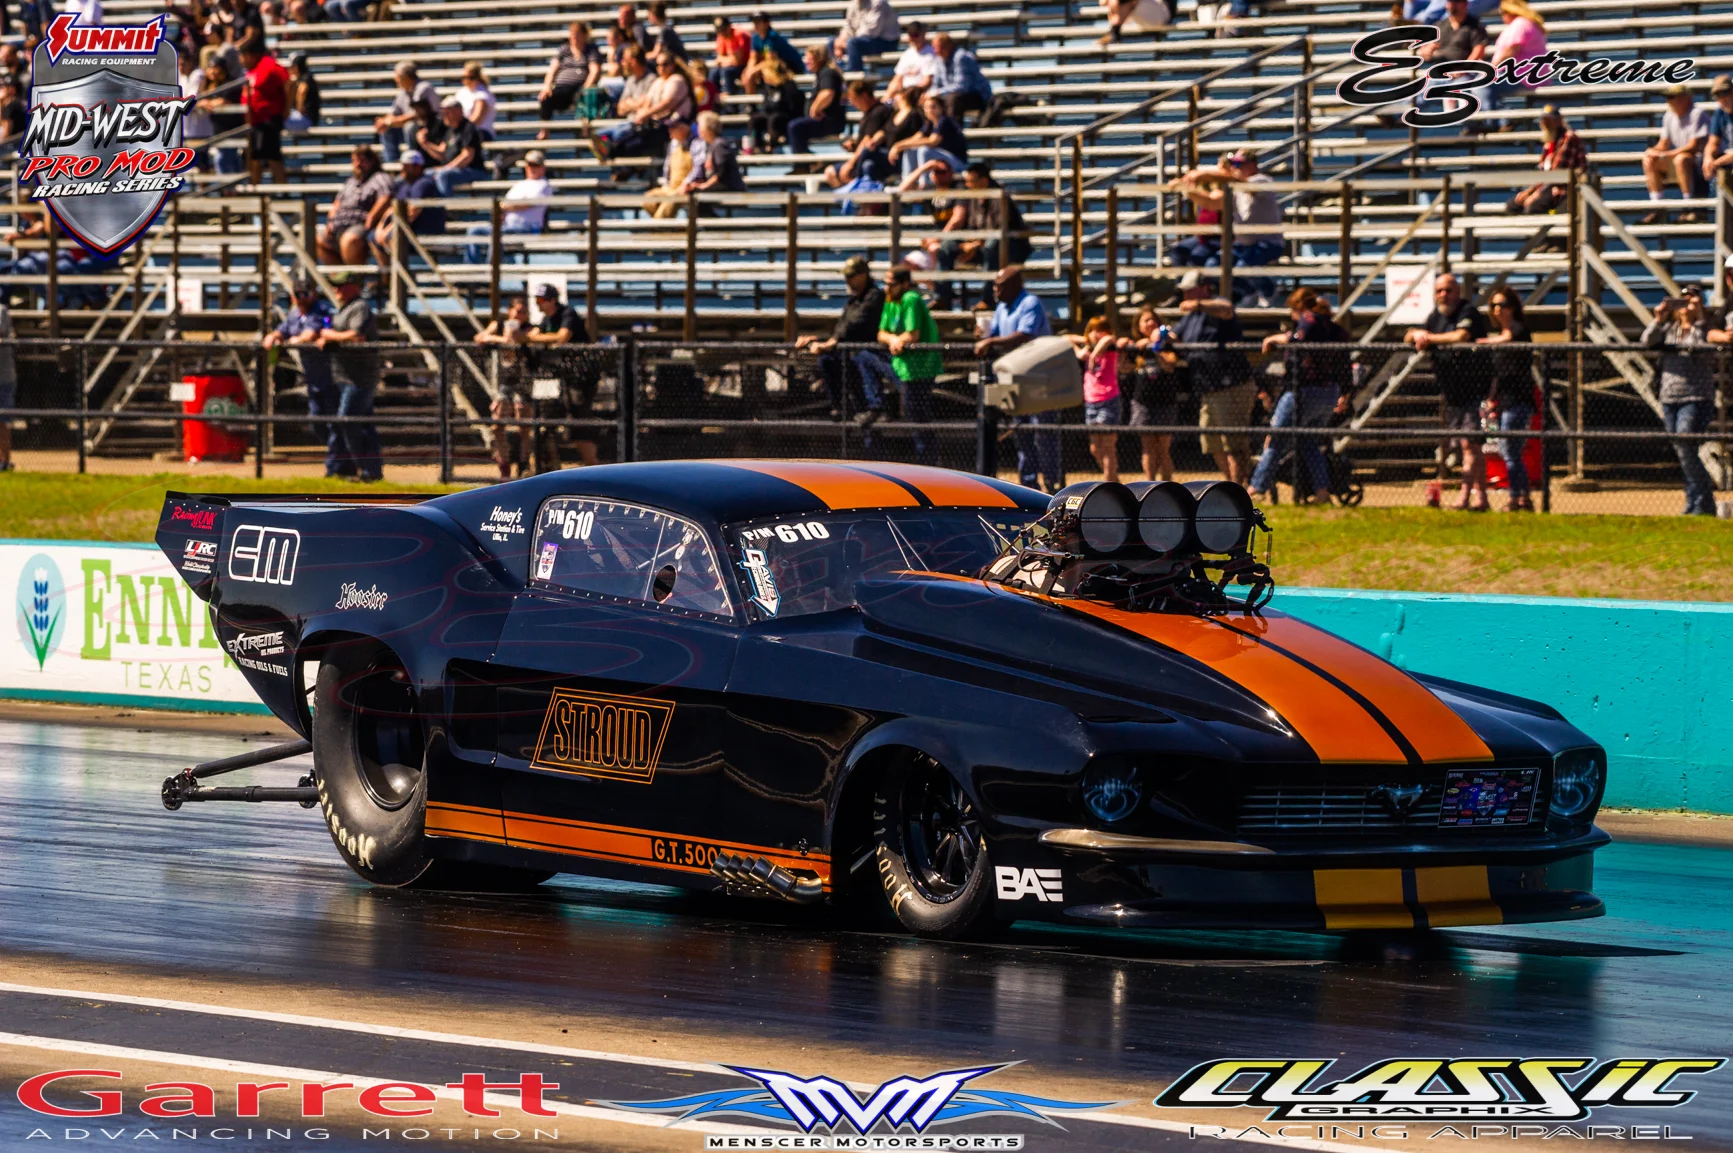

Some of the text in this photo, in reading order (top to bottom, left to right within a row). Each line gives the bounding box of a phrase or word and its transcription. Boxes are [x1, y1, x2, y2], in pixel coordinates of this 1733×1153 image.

[480, 522, 526, 534] Service Station & Tire
[489, 505, 523, 527] Honey's
[548, 509, 594, 540] P/M 610
[742, 521, 831, 543] P/M 610
[80, 558, 240, 671] ENNI
[226, 631, 285, 660] EXTREME
[121, 661, 212, 693] TEXAS
[238, 656, 257, 669] RACING
[256, 661, 268, 672] OILS
[272, 664, 288, 677] FUELS
[553, 699, 652, 770] STROUD
[654, 838, 719, 868] G.T.500
[994, 865, 1064, 902] BAE
